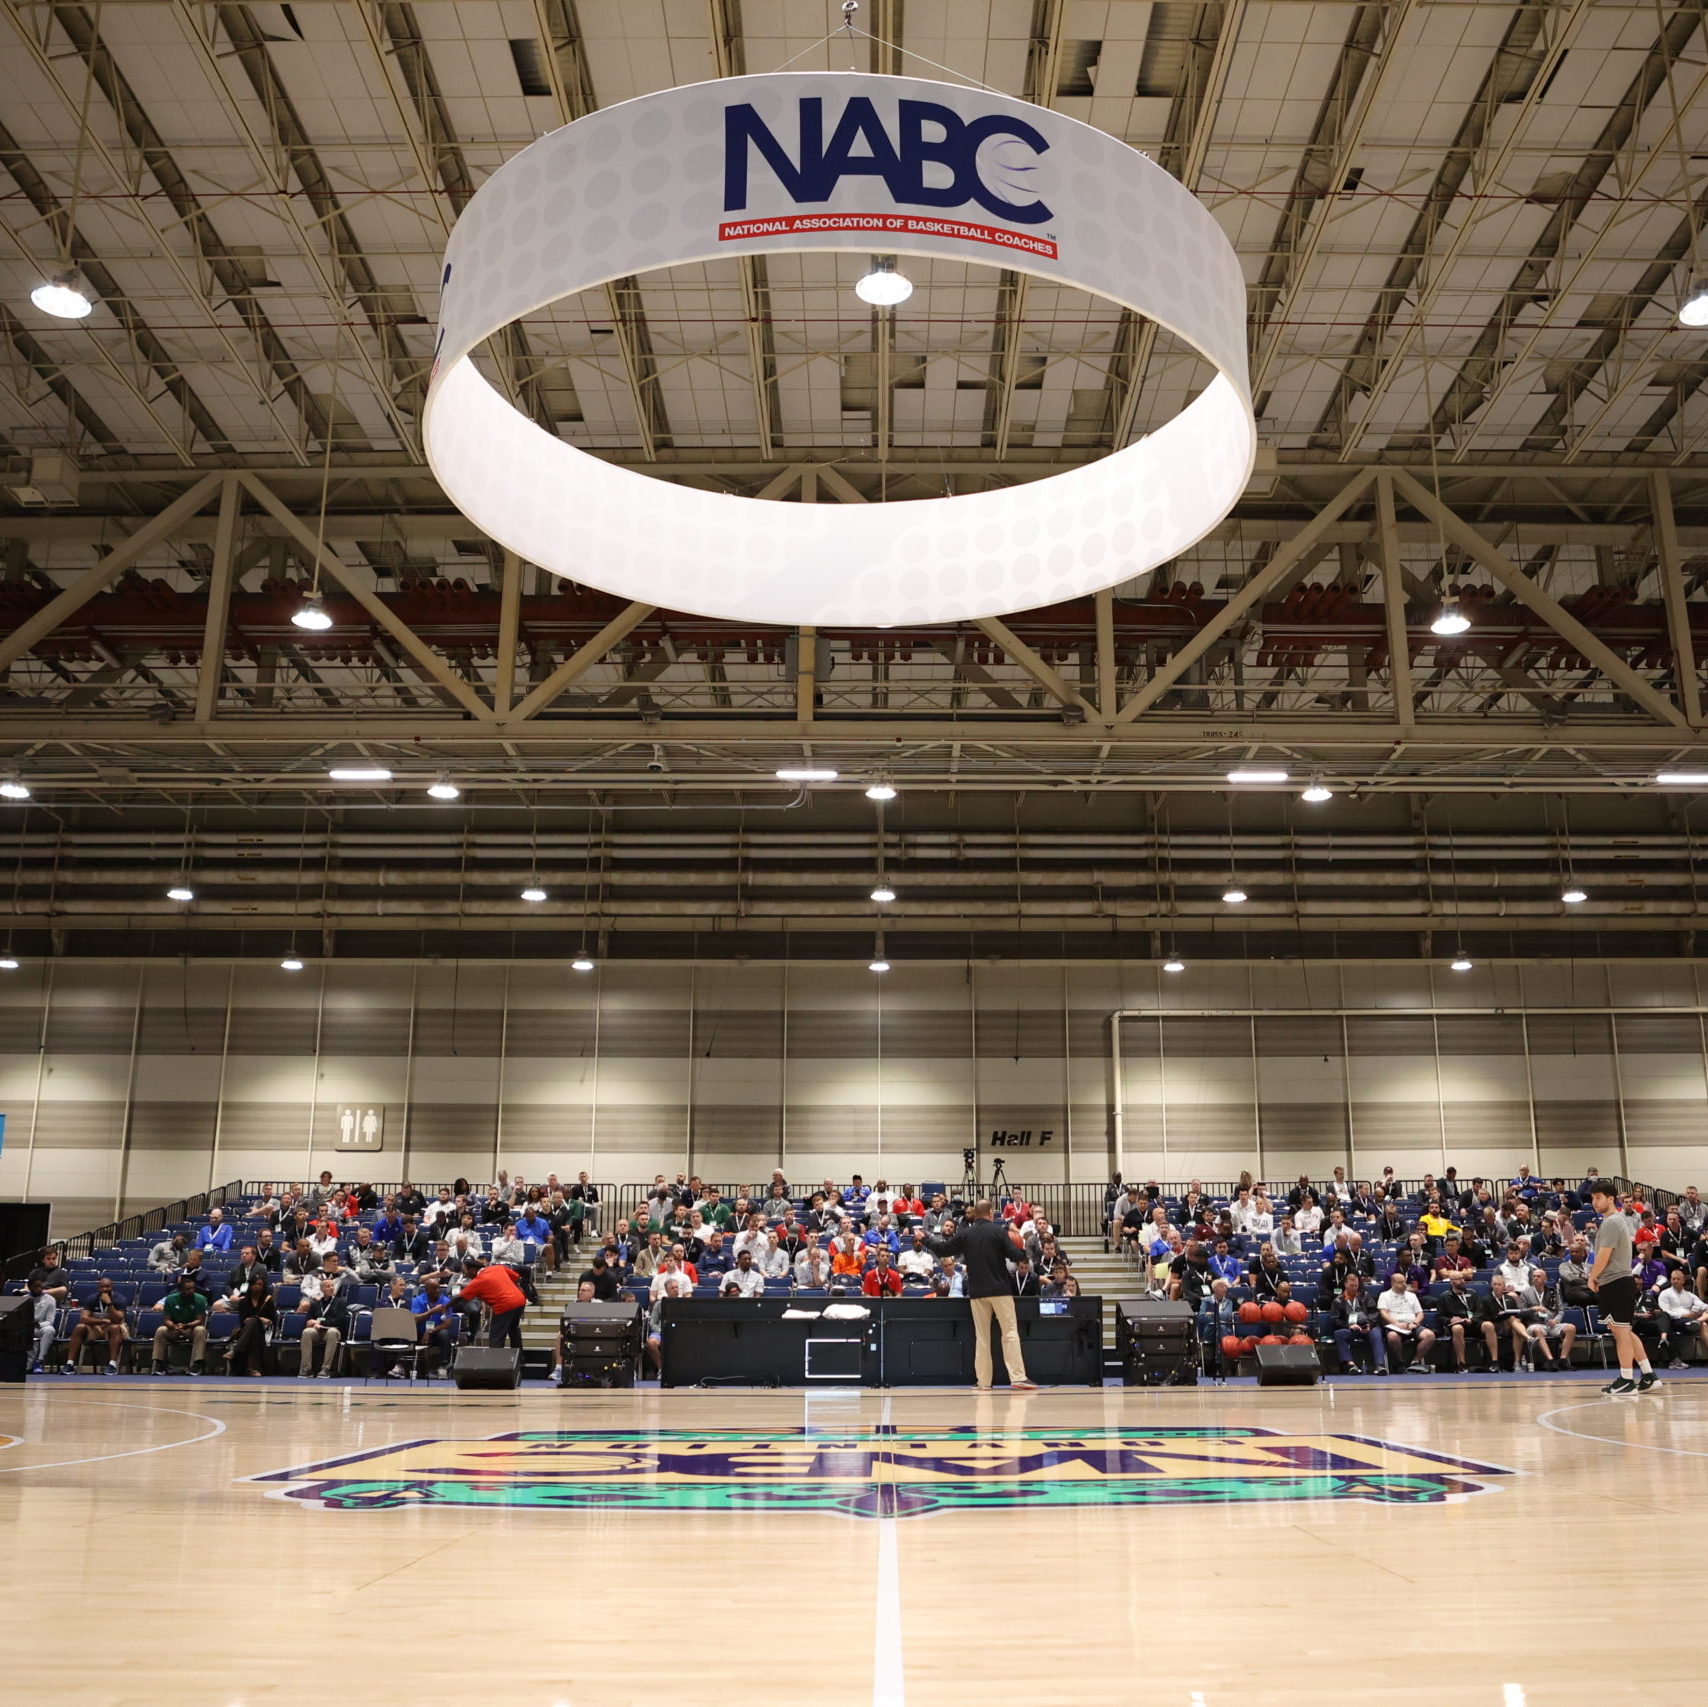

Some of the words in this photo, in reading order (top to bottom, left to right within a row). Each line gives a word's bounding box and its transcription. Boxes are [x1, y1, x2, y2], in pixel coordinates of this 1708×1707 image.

[724, 97, 1054, 224] NABC
[724, 220, 790, 236] NATIONAL
[793, 216, 883, 230] ASSOCIATION
[886, 217, 904, 229] OF
[907, 220, 992, 240] BASKETBALL
[994, 232, 1053, 255] COACHES
[991, 1130, 1032, 1146] Hall
[1039, 1130, 1054, 1146] F
[526, 1439, 1245, 1448] CONVENTION
[403, 1446, 1386, 1478] NABC
